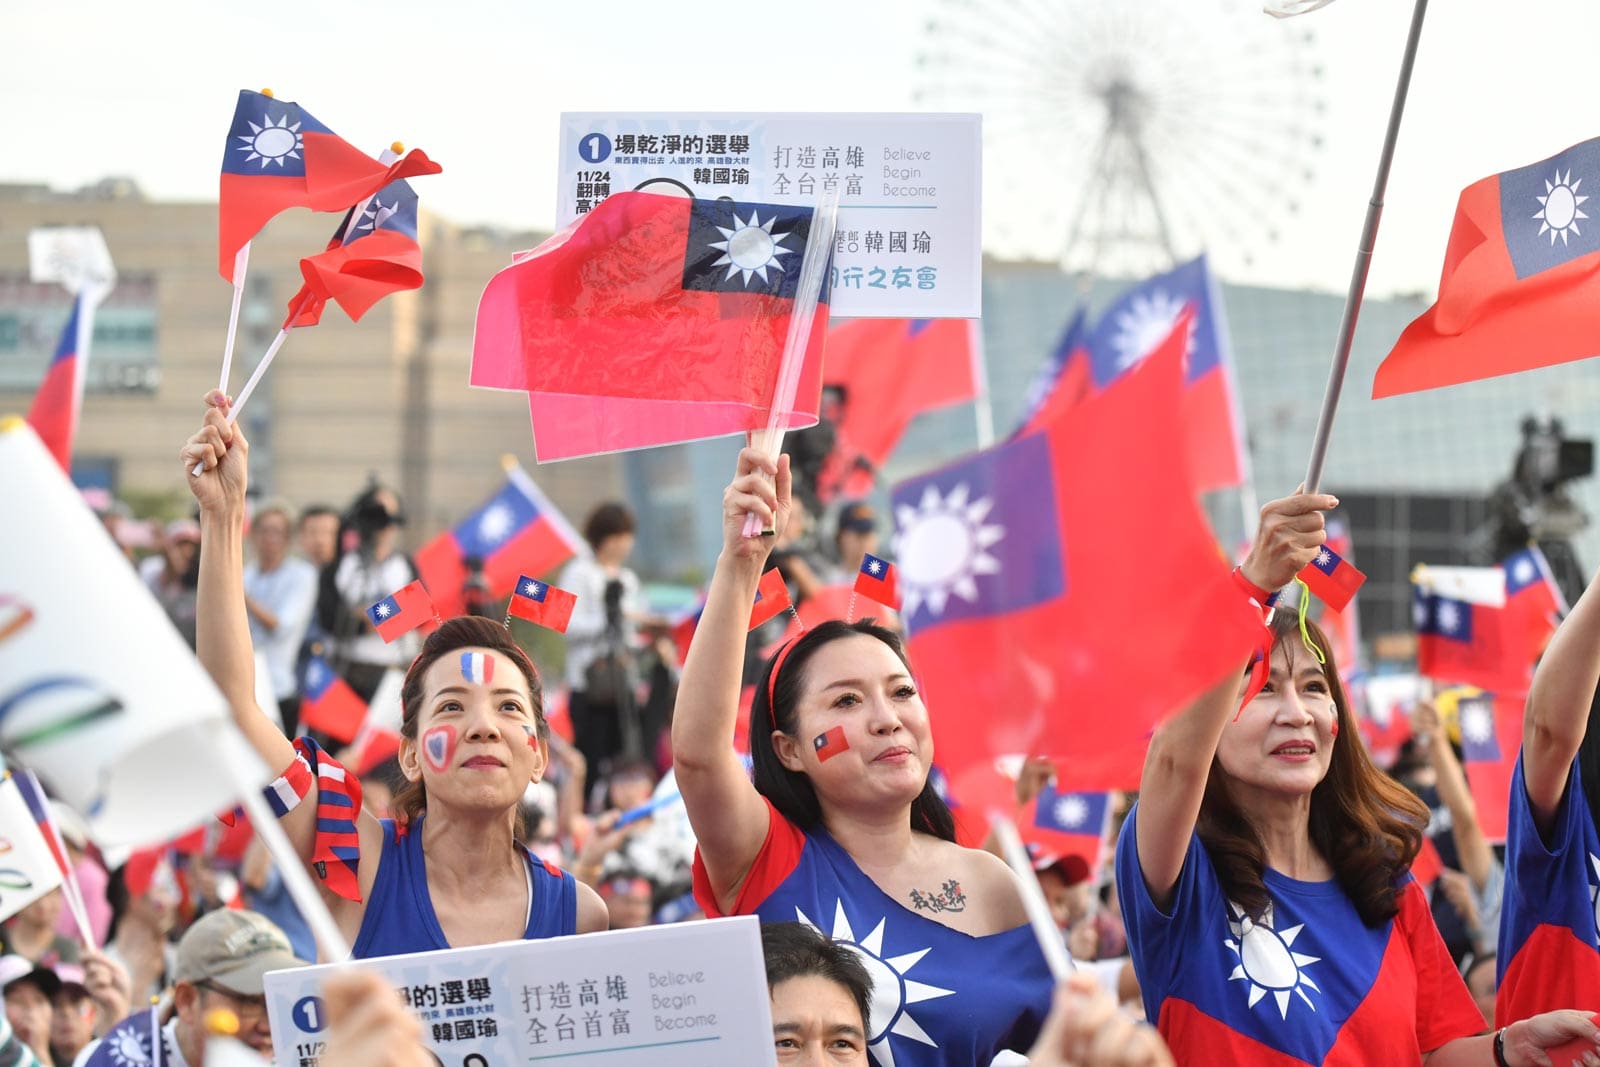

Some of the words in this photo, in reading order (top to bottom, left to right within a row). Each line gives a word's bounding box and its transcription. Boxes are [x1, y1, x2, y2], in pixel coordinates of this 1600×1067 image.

[614, 134, 750, 155] 場乾淨的選舉
[883, 146, 931, 161] Believe
[772, 145, 866, 169] 打造高雄
[577, 171, 611, 182] 11/24
[693, 167, 750, 185] 韓國瑜
[883, 165, 921, 181] Begin
[577, 183, 610, 198] 翻轉
[772, 172, 864, 195] 全台首富
[883, 183, 936, 197] Become
[837, 242, 859, 253] EO
[865, 230, 931, 254] 韓國瑜
[648, 970, 705, 988] Believe
[521, 975, 629, 1014] 打造高雄
[651, 993, 697, 1010] Begin
[432, 1017, 498, 1043] 韓國瑜
[526, 1008, 631, 1045] 全台首富
[654, 1013, 718, 1032] Become
[297, 1041, 327, 1057] 11/2
